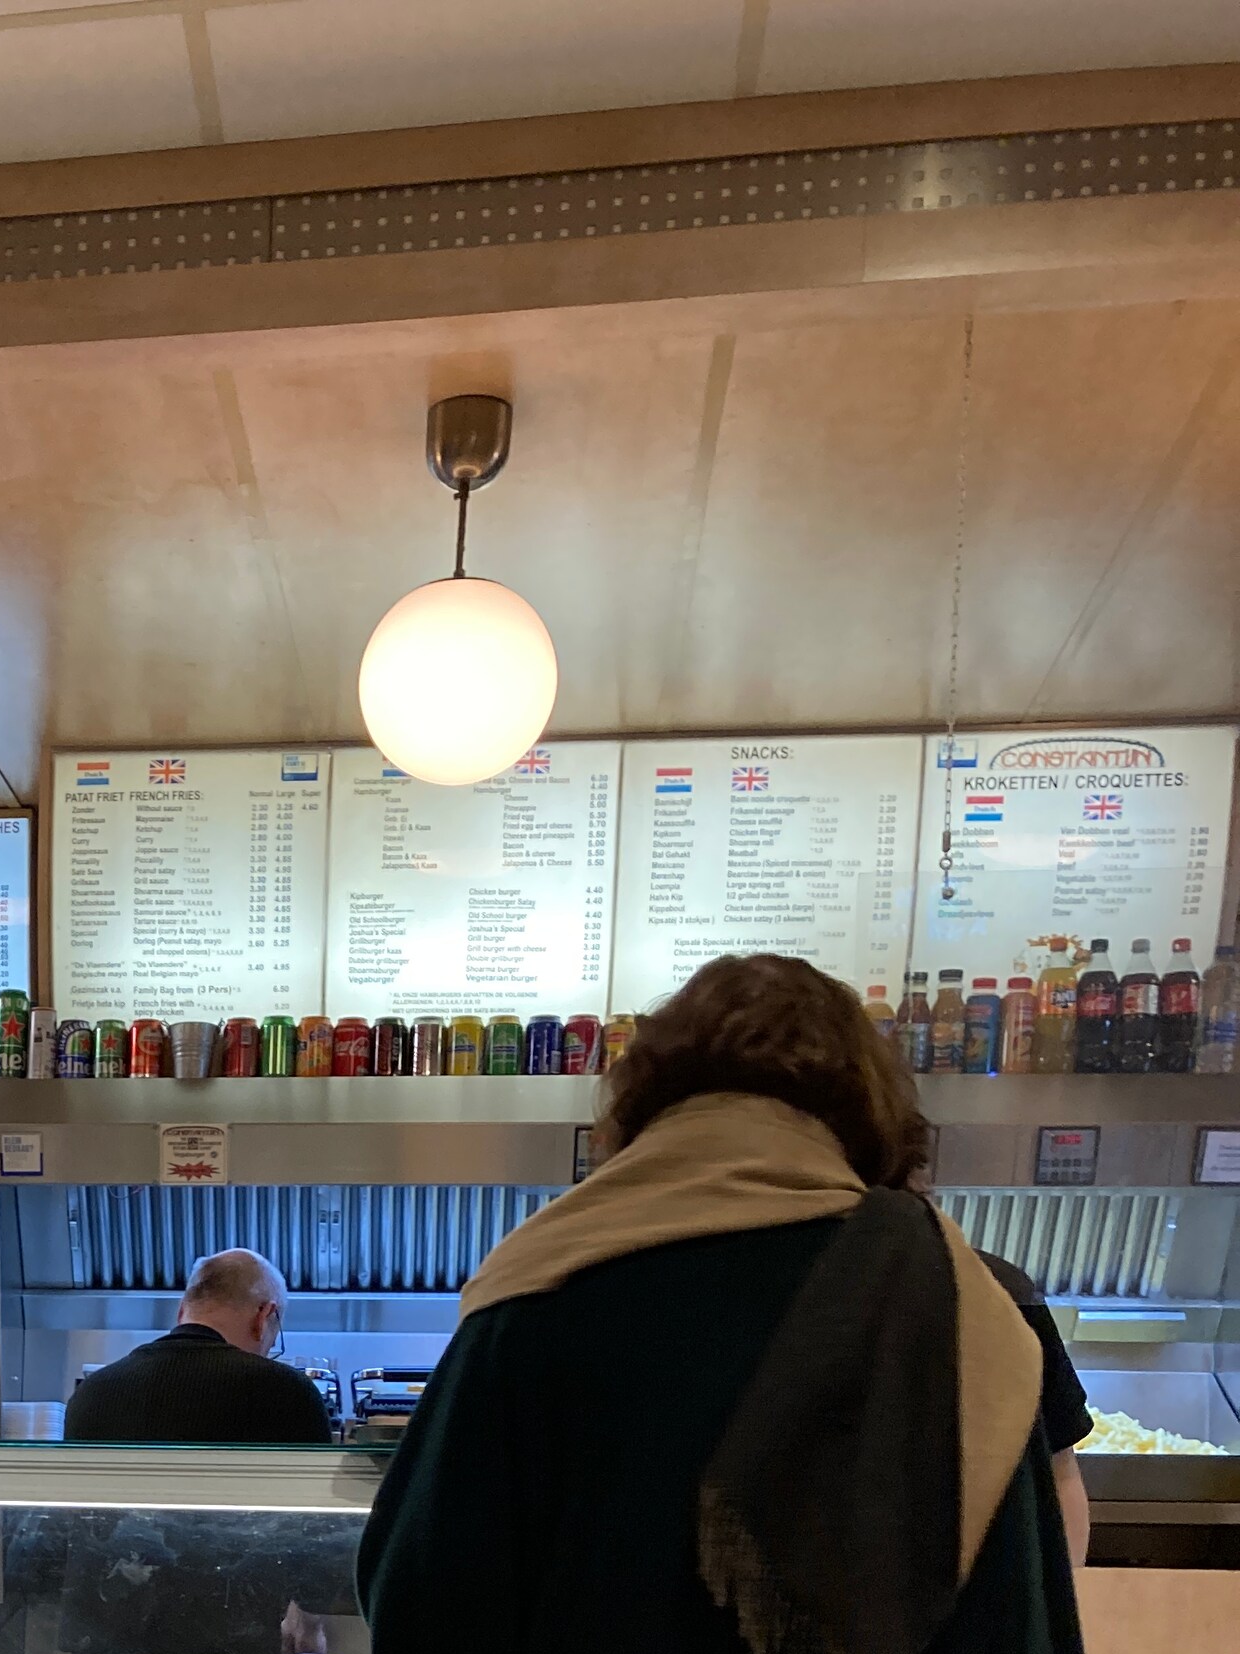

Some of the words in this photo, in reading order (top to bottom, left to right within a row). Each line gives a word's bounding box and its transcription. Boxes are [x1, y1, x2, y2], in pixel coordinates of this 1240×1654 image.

[731, 746, 794, 760] SNACKS:
[964, 775, 1058, 790] KROKETTEN
[1075, 772, 1188, 788] CROQUETTES:
[249, 790, 273, 798] Normal
[276, 790, 296, 798] Large
[301, 790, 321, 798] Super
[354, 788, 392, 796] Hamburger
[65, 792, 94, 803] PATAT
[97, 792, 124, 802] FRIET
[130, 791, 170, 800] FRENCH
[172, 790, 204, 800] FRIES:
[136, 836, 154, 844] Curry
[586, 886, 604, 894] 4.40
[748, 882, 772, 890] spring
[498, 888, 521, 896] burger
[381, 928, 406, 936] Special
[349, 948, 385, 956] Grillburger
[348, 976, 394, 984] Vegaburger
[466, 974, 508, 982] Vegetarian
[510, 974, 538, 982] burger
[133, 986, 158, 994] Family
[160, 986, 174, 994] Bag
[176, 986, 194, 994] from
[197, 986, 207, 994] (3
[208, 986, 232, 994] Pers)
[133, 1000, 159, 1008] French
[134, 1008, 153, 1016] spicy
[156, 1008, 184, 1016] chicken
